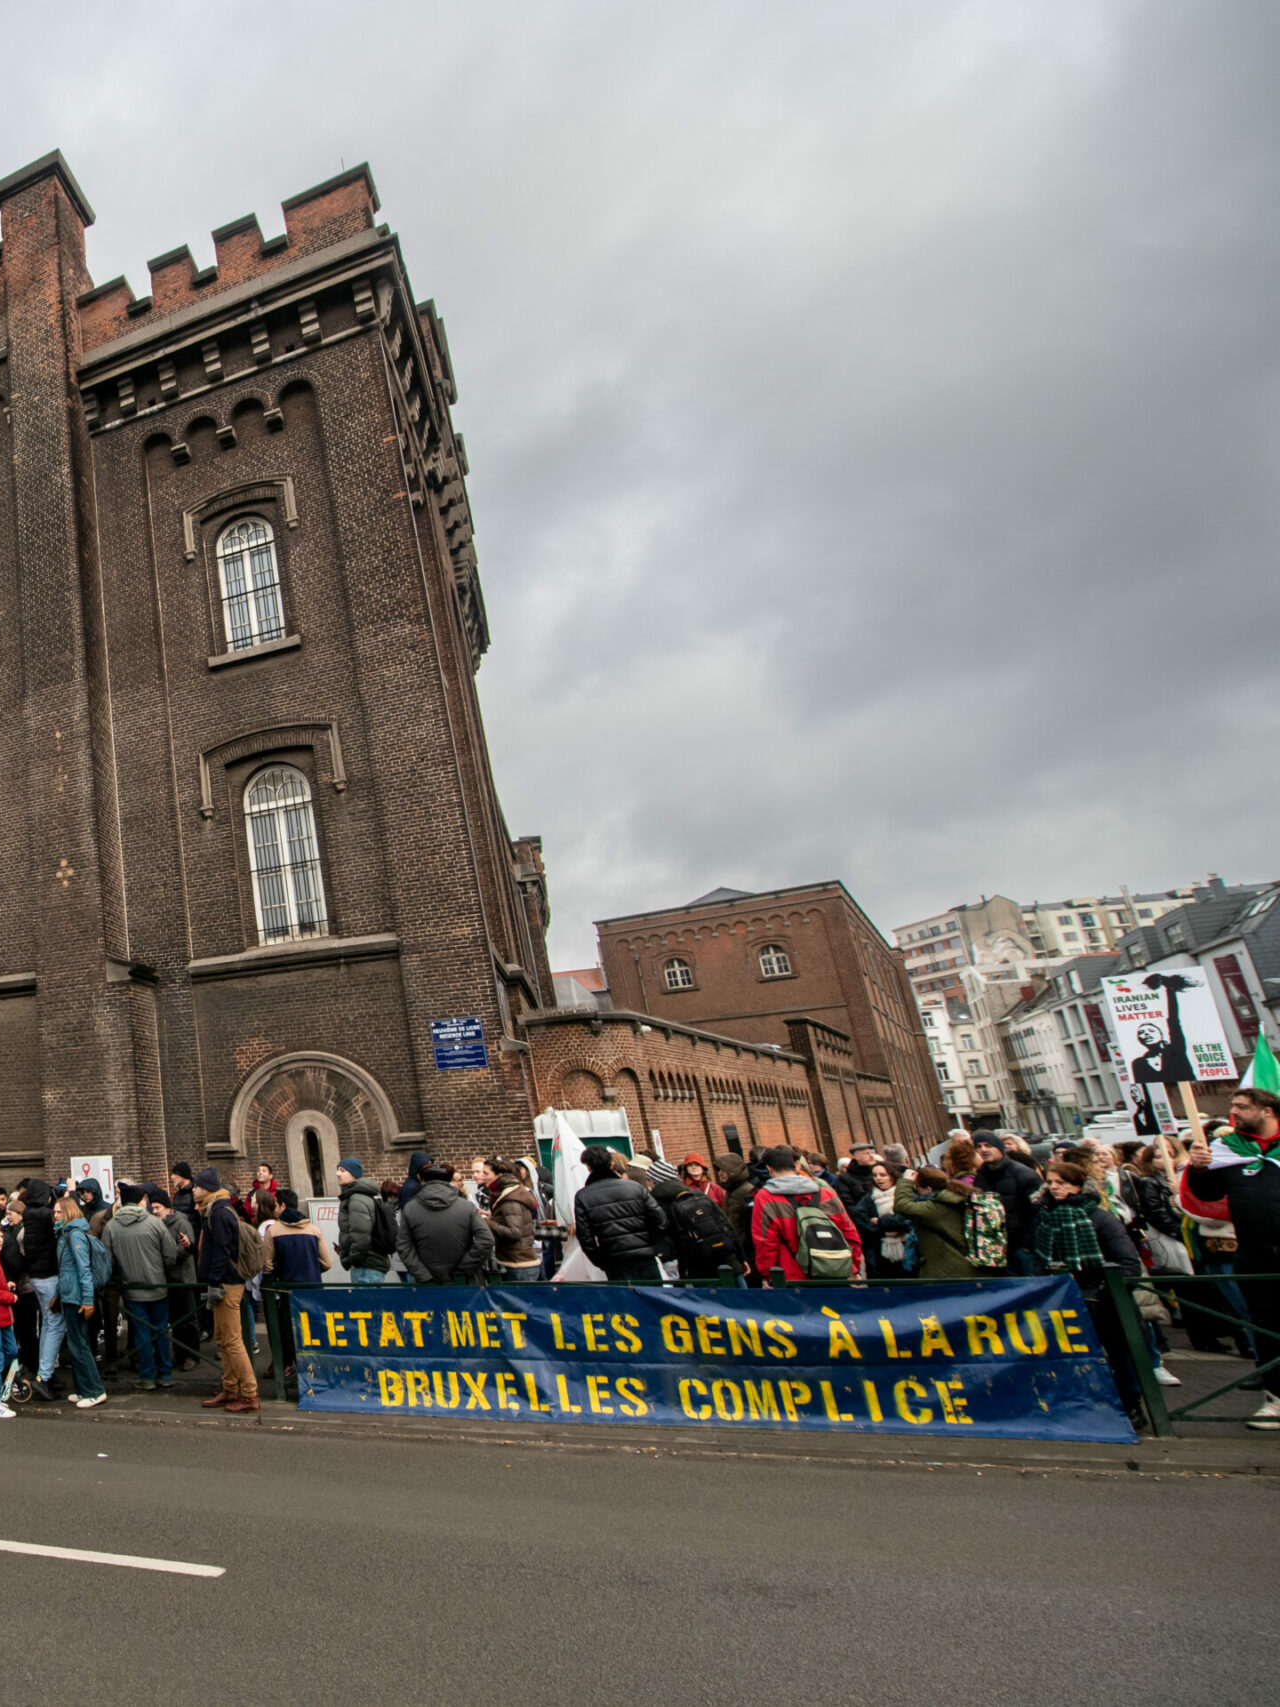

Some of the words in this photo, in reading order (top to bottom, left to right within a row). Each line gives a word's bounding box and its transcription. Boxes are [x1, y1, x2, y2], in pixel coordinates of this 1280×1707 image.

[1113, 993, 1160, 1003] IRANIAN
[1116, 1003, 1148, 1012] LIVES
[1118, 1010, 1163, 1021] MATTER
[1193, 1044, 1205, 1053] BE
[1206, 1043, 1223, 1052] THE
[1195, 1052, 1226, 1062] VOICE
[1200, 1068, 1231, 1077] PEOPLE
[299, 1311, 432, 1348] LETAT
[445, 1310, 528, 1349] MET
[550, 1312, 643, 1354] LES
[659, 1314, 798, 1359] GENS
[820, 1305, 862, 1359] À
[878, 1313, 955, 1359] LA
[962, 1308, 1090, 1356] RUE
[377, 1369, 649, 1417] BRUXELLES
[678, 1376, 974, 1425] COMPLICE
